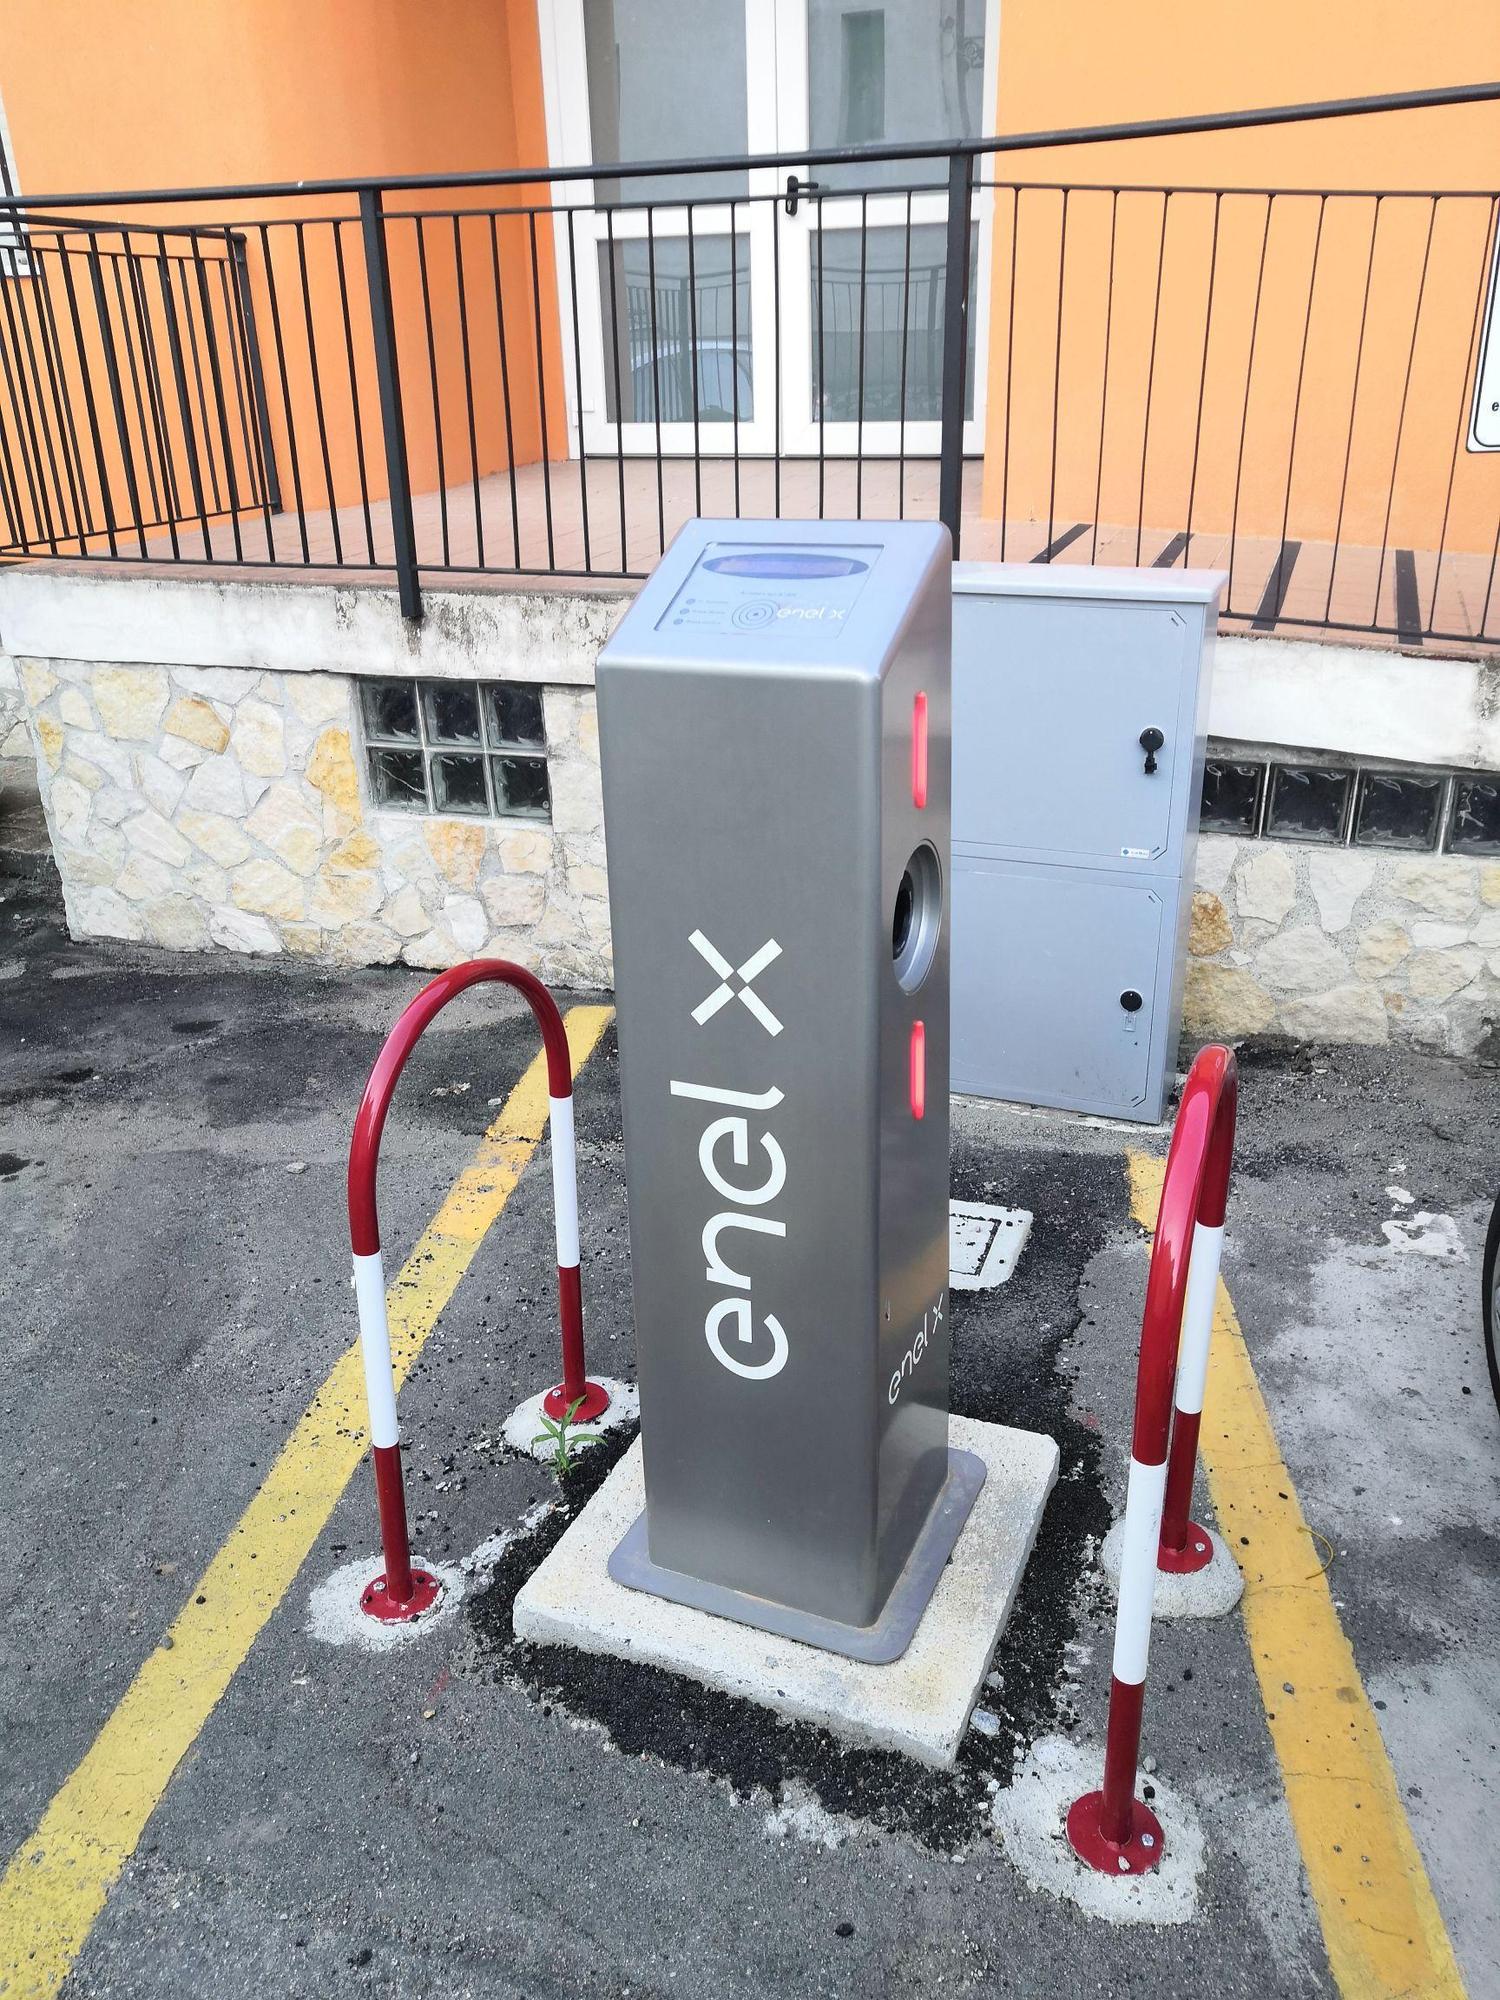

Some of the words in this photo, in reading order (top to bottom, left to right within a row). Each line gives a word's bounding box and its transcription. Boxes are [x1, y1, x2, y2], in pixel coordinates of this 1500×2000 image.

[776, 606, 825, 620] enel
[670, 1080, 789, 1381] enel
[888, 1312, 928, 1405] enel
